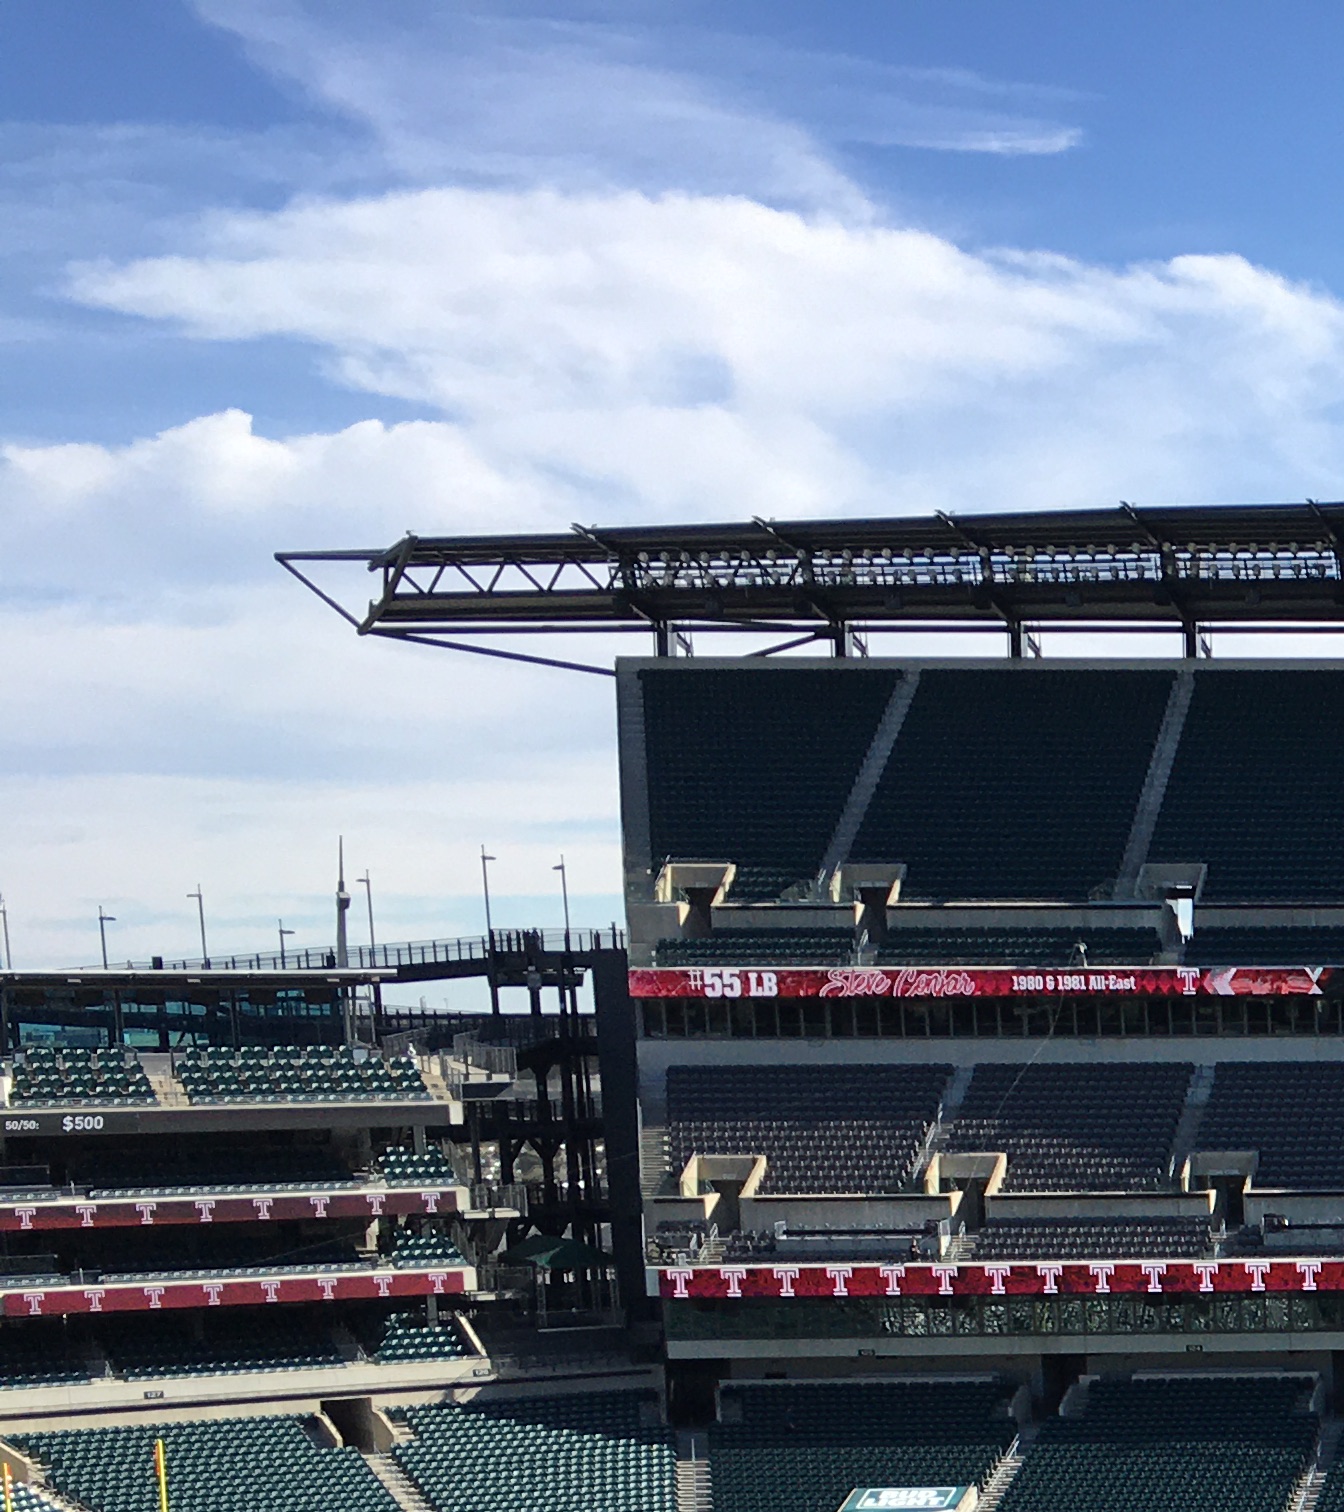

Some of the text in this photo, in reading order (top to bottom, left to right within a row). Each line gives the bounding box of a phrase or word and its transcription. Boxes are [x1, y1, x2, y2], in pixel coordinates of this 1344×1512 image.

[688, 969, 777, 998] #55 LB
[1011, 974, 1043, 991] 1980
[1056, 974, 1087, 991] 1981
[1089, 974, 1136, 992] All-East
[5, 1115, 104, 1132] 50/50: $500
[863, 1497, 945, 1507] LIGHT
[879, 1490, 938, 1498] BUD
